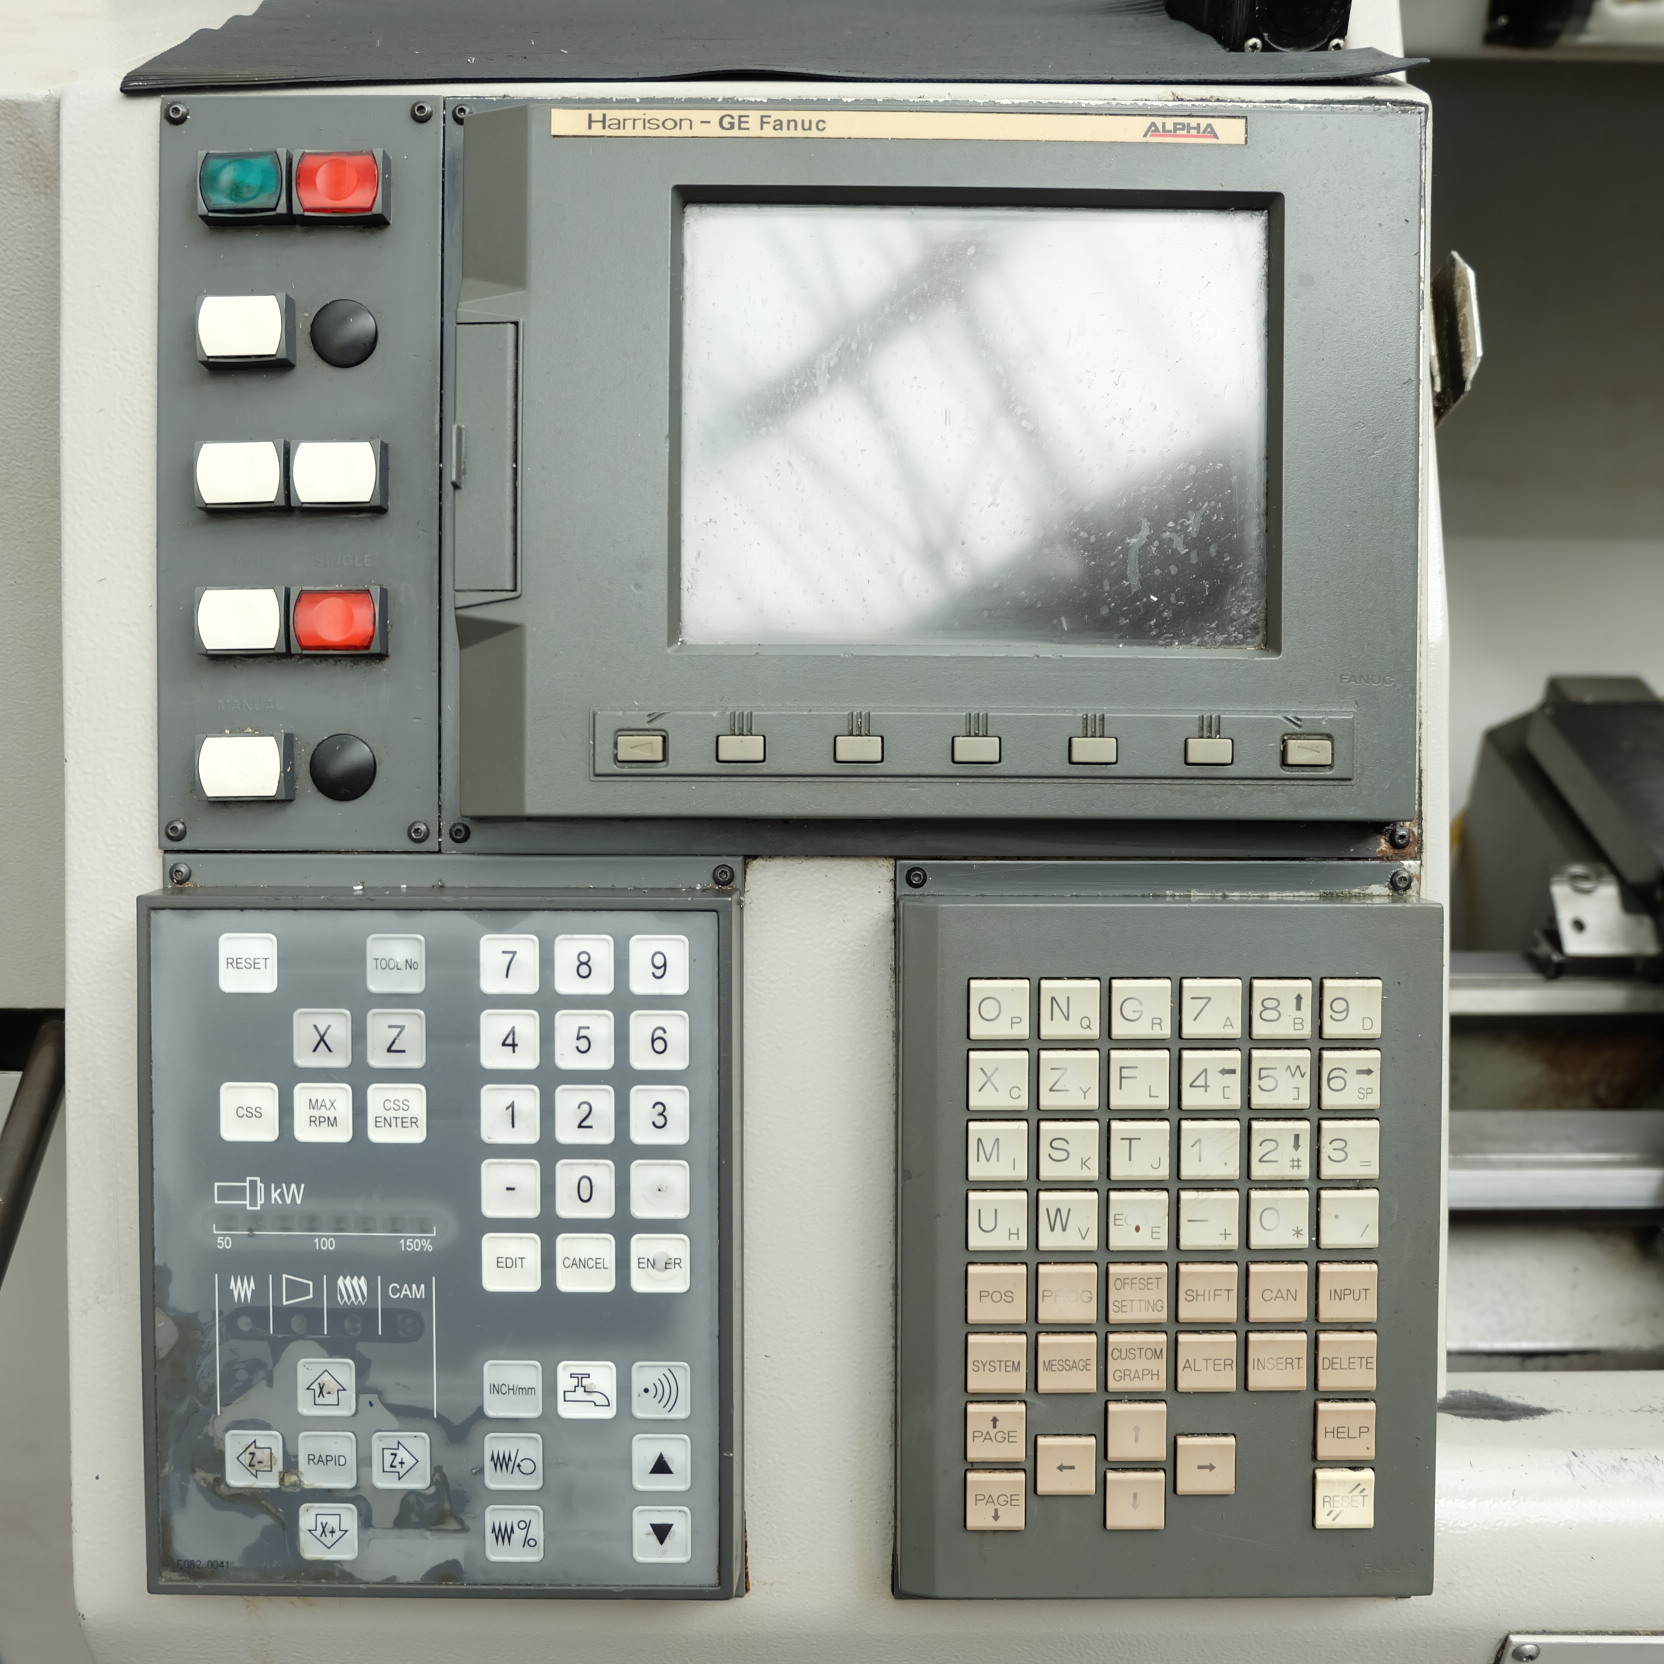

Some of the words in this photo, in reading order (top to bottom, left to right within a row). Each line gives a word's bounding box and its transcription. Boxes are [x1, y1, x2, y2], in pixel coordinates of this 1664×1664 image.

[587, 113, 693, 131] Harrison
[718, 114, 750, 131] GE
[759, 115, 827, 132] Fanuc
[1142, 121, 1219, 140] ALPHA
[314, 554, 373, 567] SINGLE
[1340, 674, 1395, 686] FANUC
[226, 958, 270, 970] RESET
[373, 958, 402, 971] TOOL
[405, 958, 419, 971] No
[501, 950, 518, 979] 7
[576, 951, 592, 979] 8
[650, 951, 668, 980] 9
[978, 996, 1002, 1022] O
[1011, 1016, 1022, 1030] P
[1050, 996, 1070, 1021] N
[1080, 1016, 1092, 1031] Q
[1120, 997, 1143, 1022] G
[1152, 1017, 1163, 1031] R
[1190, 996, 1212, 1022] 7
[1223, 1016, 1234, 1029] A
[1259, 997, 1282, 1022] 8
[1293, 1017, 1304, 1031] B
[1329, 997, 1350, 1022] 9
[1362, 1017, 1373, 1031] D
[312, 1024, 333, 1053] X
[386, 1025, 406, 1053] Z
[501, 1025, 518, 1054] 4
[575, 1026, 592, 1054] 5
[650, 1026, 668, 1054] 6
[978, 1067, 999, 1093] X
[1009, 1086, 1022, 1100] C
[1048, 1067, 1070, 1093] Z
[1079, 1087, 1091, 1100] Y
[1119, 1066, 1138, 1090] F
[1149, 1085, 1159, 1098] L
[1189, 1068, 1210, 1093] 4
[1258, 1067, 1278, 1092] 5
[1327, 1067, 1348, 1092] 6
[1357, 1087, 1373, 1100] SP
[236, 1107, 263, 1119] CSS
[308, 1099, 337, 1111] MAX
[383, 1099, 410, 1112] CSS
[309, 1116, 338, 1128] RPM
[505, 1101, 515, 1128] 1
[577, 1101, 593, 1129] 2
[651, 1101, 668, 1129] 3
[374, 1117, 419, 1129] ENTER
[976, 1137, 1000, 1163] M
[1048, 1138, 1070, 1162] S
[1081, 1157, 1091, 1171] K
[1120, 1137, 1141, 1162] T
[1151, 1157, 1161, 1170] J
[1191, 1138, 1202, 1163] 1
[1258, 1138, 1279, 1163] 2
[1327, 1138, 1348, 1163] 3
[271, 1183, 305, 1204] kW
[576, 1175, 594, 1203] 0
[978, 1208, 998, 1233] U
[1008, 1227, 1020, 1241] H
[1046, 1207, 1071, 1232] W
[1078, 1227, 1090, 1241] V
[1150, 1225, 1161, 1240] E
[217, 1237, 232, 1249] 50
[314, 1238, 335, 1250] 100
[399, 1239, 433, 1252] 150%
[497, 1257, 526, 1269] EDIT
[562, 1257, 609, 1270] CANCEL
[637, 1257, 682, 1270] ENER
[389, 1284, 425, 1299] CAM
[1114, 1277, 1162, 1291] OFFSET
[979, 1290, 1014, 1303] POS
[1184, 1289, 1234, 1302] SHIFT
[1261, 1288, 1298, 1302] CAN
[1329, 1288, 1370, 1301] INPUT
[1112, 1299, 1164, 1313] SETTING
[1111, 1348, 1163, 1361] CUSTOM
[972, 1360, 1021, 1373] SYSTEM
[1043, 1359, 1092, 1372] MESSAGE
[1182, 1359, 1234, 1371] ALTER
[1252, 1357, 1303, 1370] INSERT
[1322, 1357, 1374, 1370] DELETE
[1113, 1369, 1160, 1382] GRAPH
[317, 1382, 332, 1399] X-
[489, 1383, 536, 1396] INCH/mm
[972, 1430, 1018, 1444] PAGE
[1324, 1426, 1370, 1439] HELP
[248, 1452, 264, 1468] Z-
[307, 1454, 347, 1467] RAPID
[389, 1453, 405, 1469] Z+
[975, 1493, 1020, 1507] PAGE
[1323, 1494, 1369, 1509] RESET
[320, 1522, 336, 1538] X+
